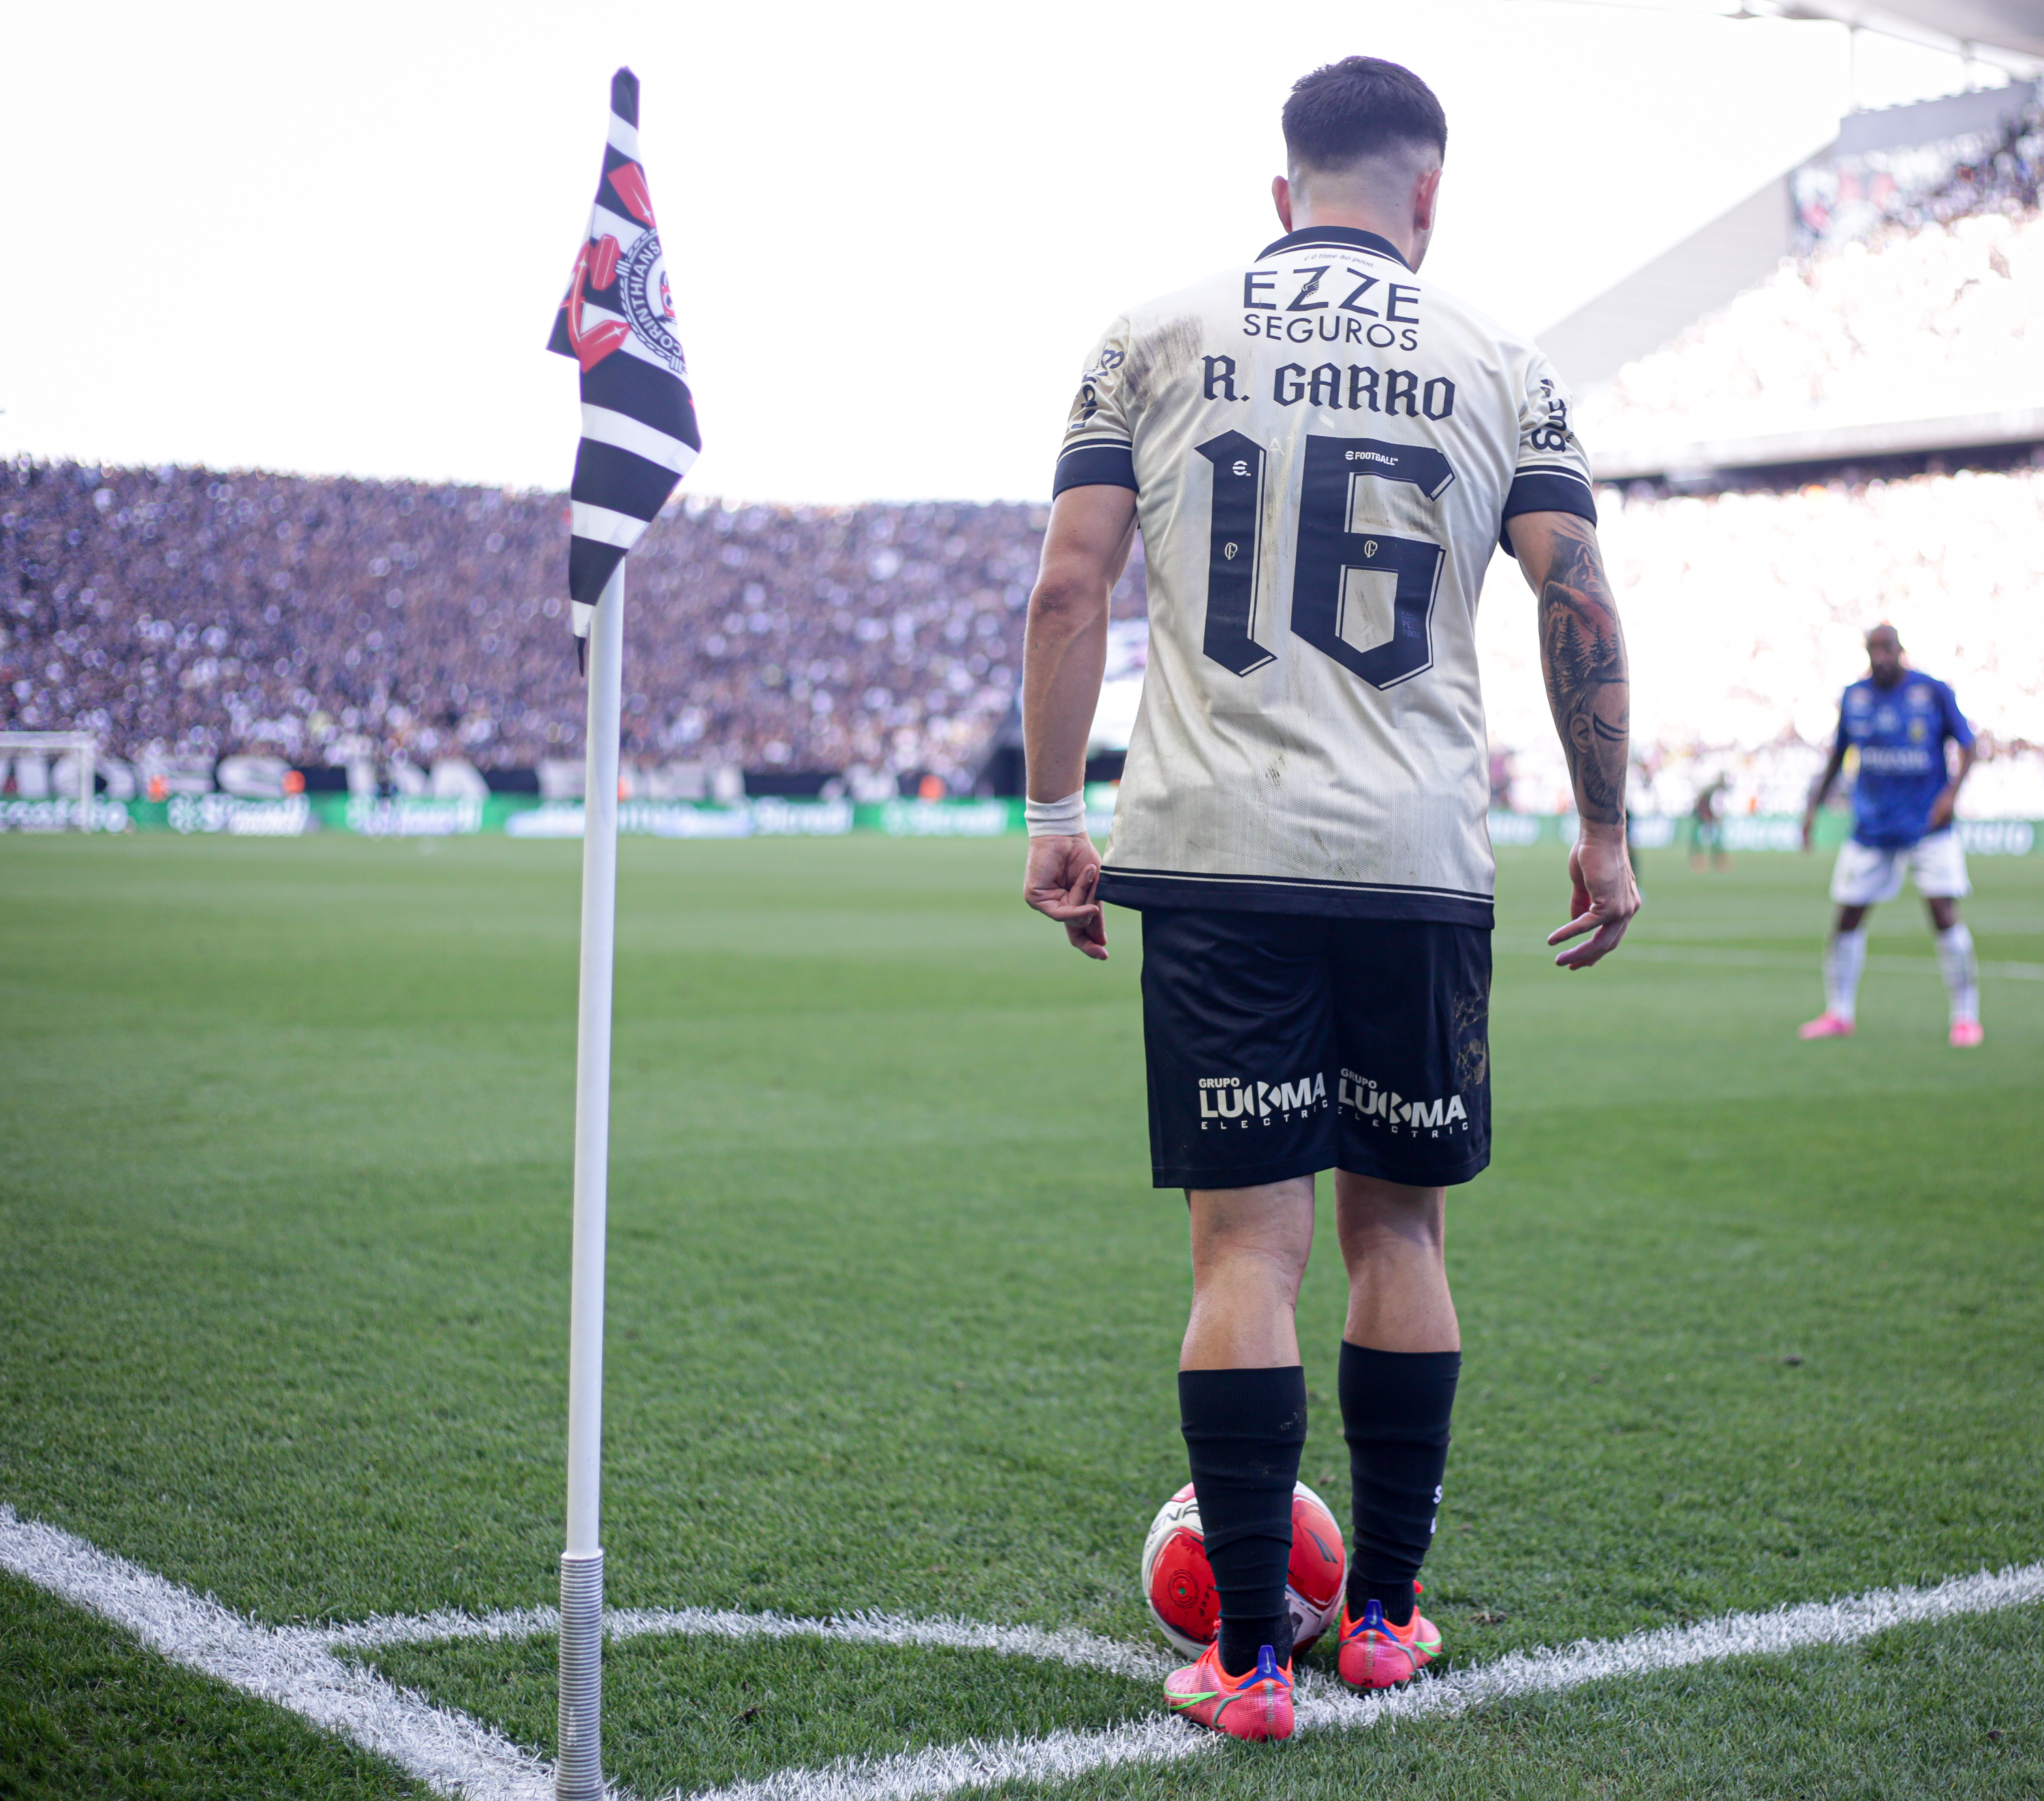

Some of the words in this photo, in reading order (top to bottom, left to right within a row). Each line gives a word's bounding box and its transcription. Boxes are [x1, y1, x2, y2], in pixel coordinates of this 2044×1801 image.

[1243, 266, 1421, 325] EZZE
[1243, 313, 1418, 351] SEGUROS
[1201, 355, 1250, 402] R.
[1273, 362, 1455, 421] GARRO
[1194, 430, 1455, 691] 16
[1198, 1077, 1240, 1088] GRUPO
[1340, 1068, 1377, 1089] GRUPO
[1201, 1099, 1328, 1130] ELECTRIC
